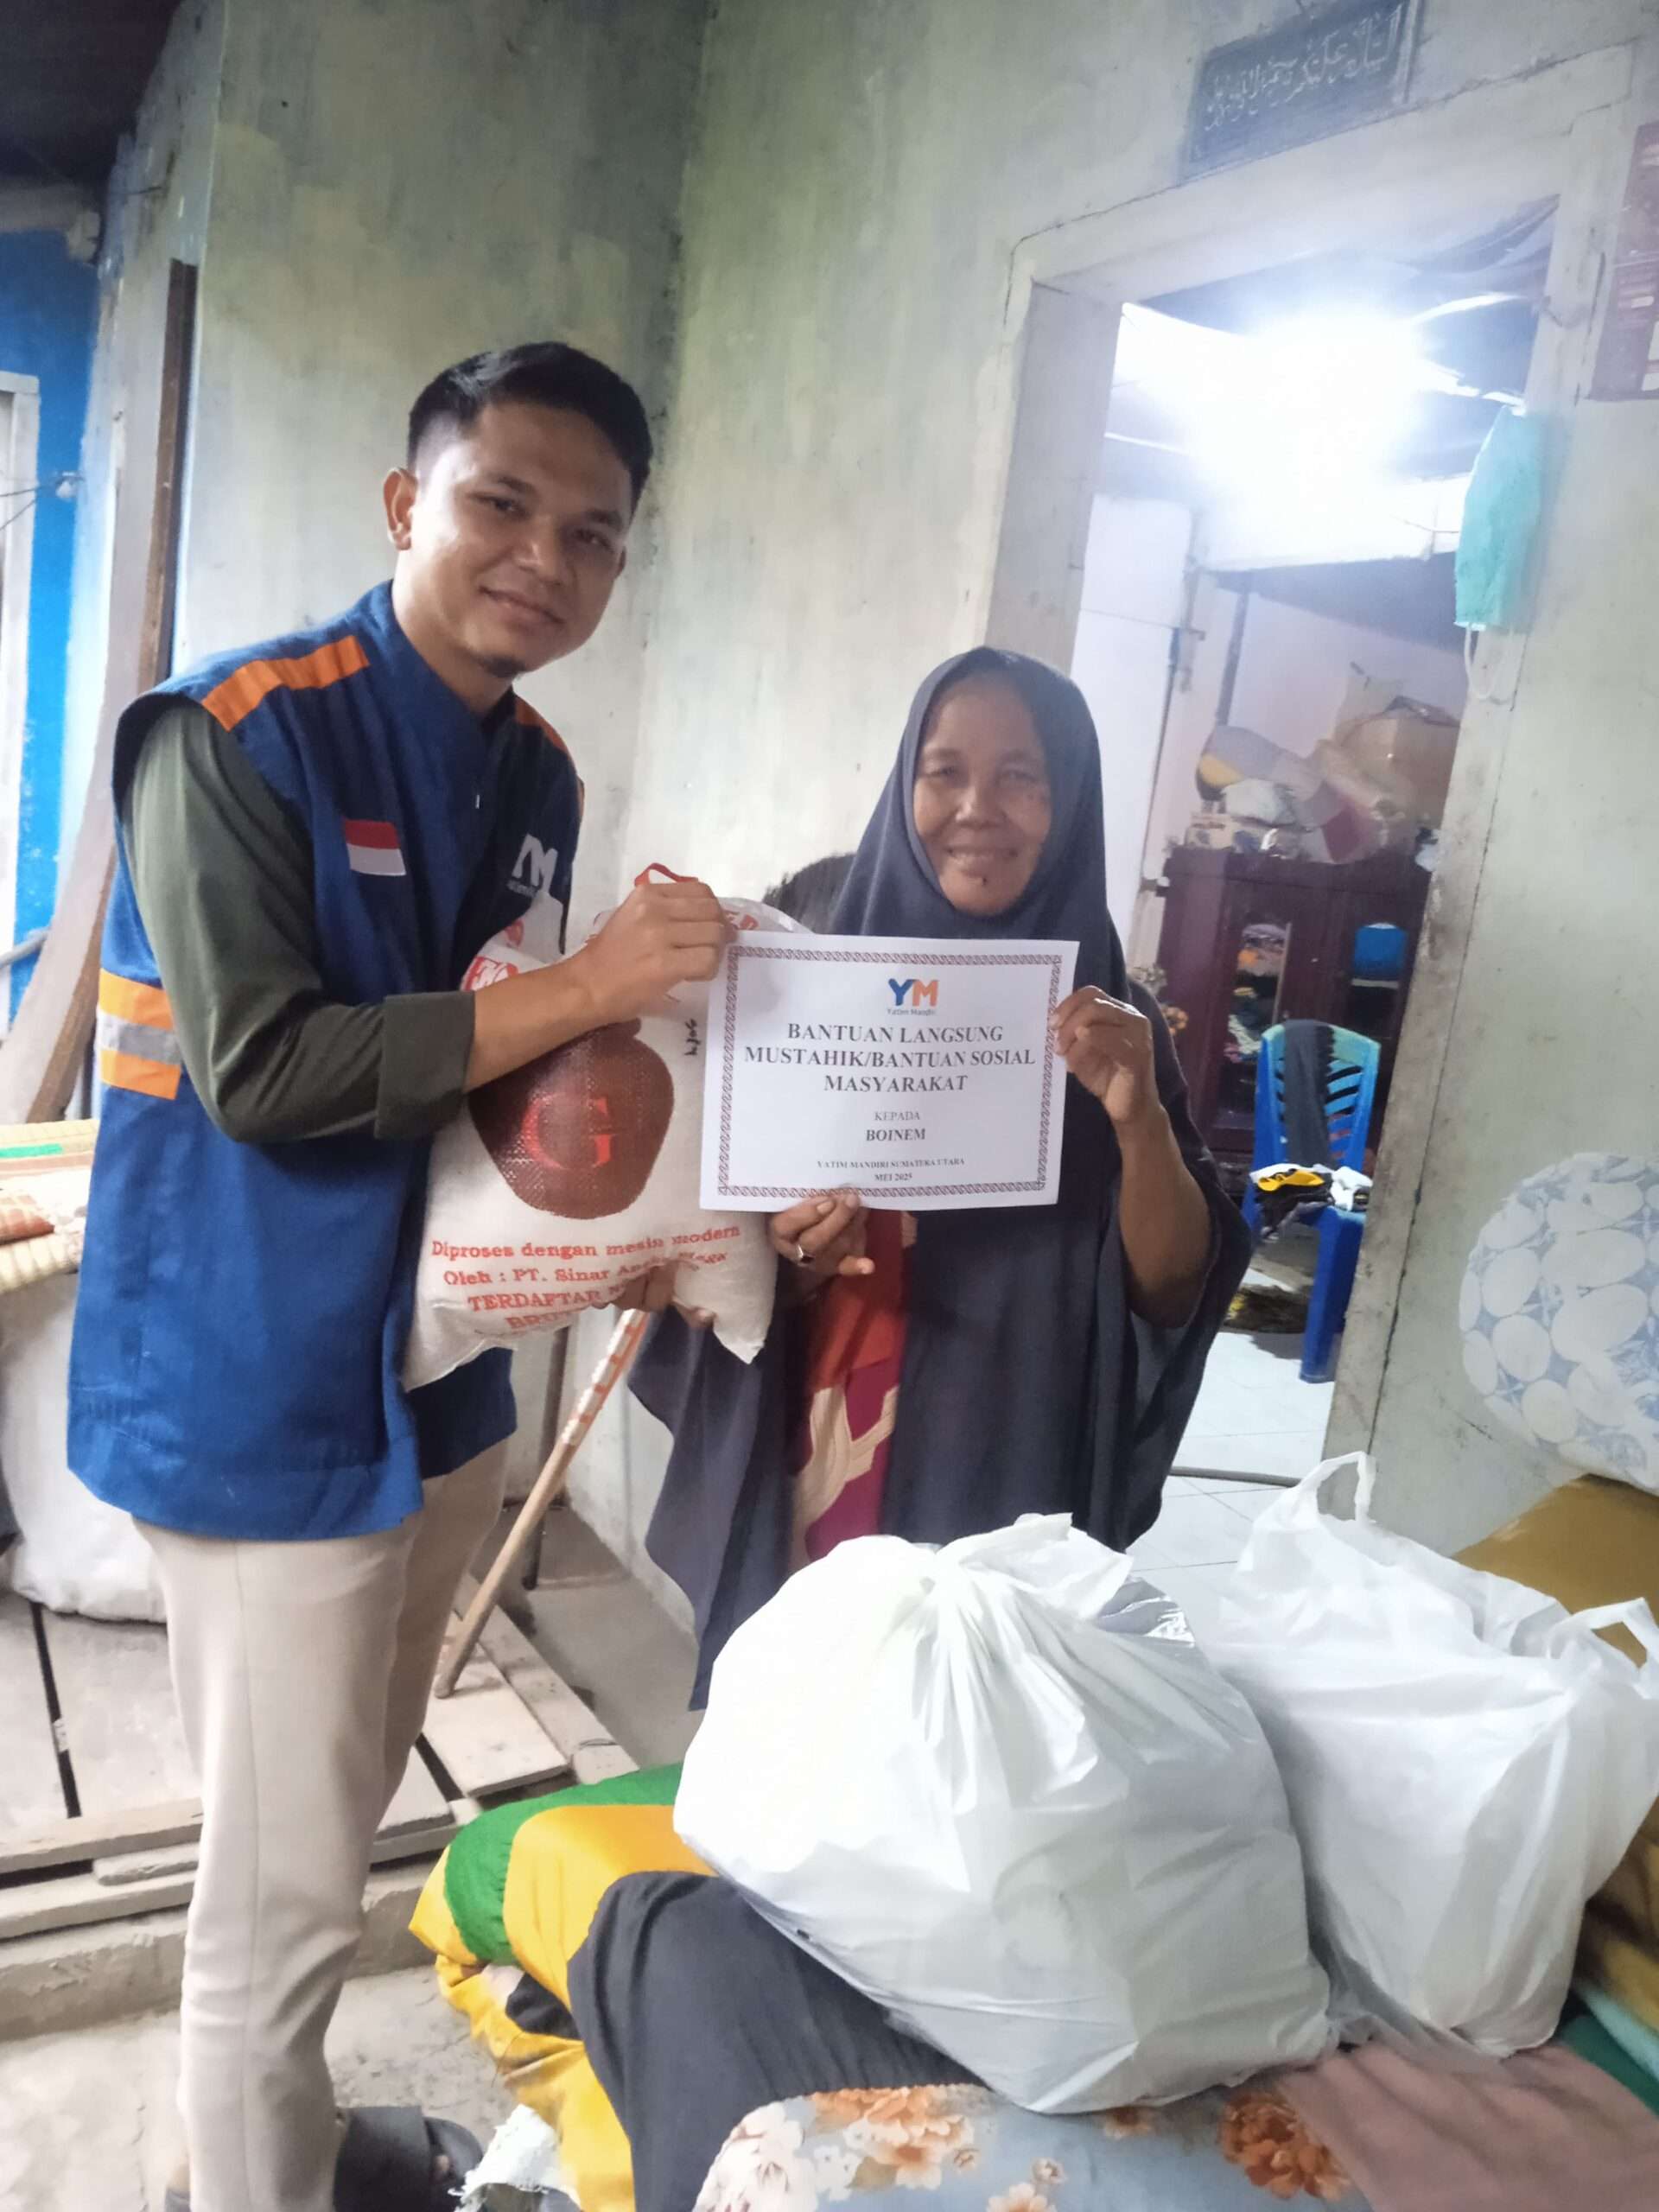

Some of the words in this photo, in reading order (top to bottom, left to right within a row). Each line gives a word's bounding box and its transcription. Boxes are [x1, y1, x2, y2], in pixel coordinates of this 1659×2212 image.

[888, 978, 939, 1007] YM
[788, 1023, 893, 1043] BANTUAN
[899, 1026, 1003, 1044] LANGSUNG
[744, 1046, 965, 1067] MUSTAHIK/BANTUAN
[969, 1049, 1035, 1066] SOSIAL
[823, 1075, 968, 1093] MASYARAKAT
[874, 1111, 920, 1121] KEPADA
[866, 1128, 925, 1141] BOINEM
[850, 1160, 889, 1169] MANDIRI
[874, 1173, 893, 1182] MEI
[432, 1241, 514, 1261] Diproses
[521, 1243, 597, 1260] dengan
[606, 1236, 664, 1255] mesin
[671, 1226, 741, 1245] modern
[443, 1271, 493, 1285] Oleh
[512, 1268, 548, 1281] PT.
[555, 1268, 608, 1281] Sinar
